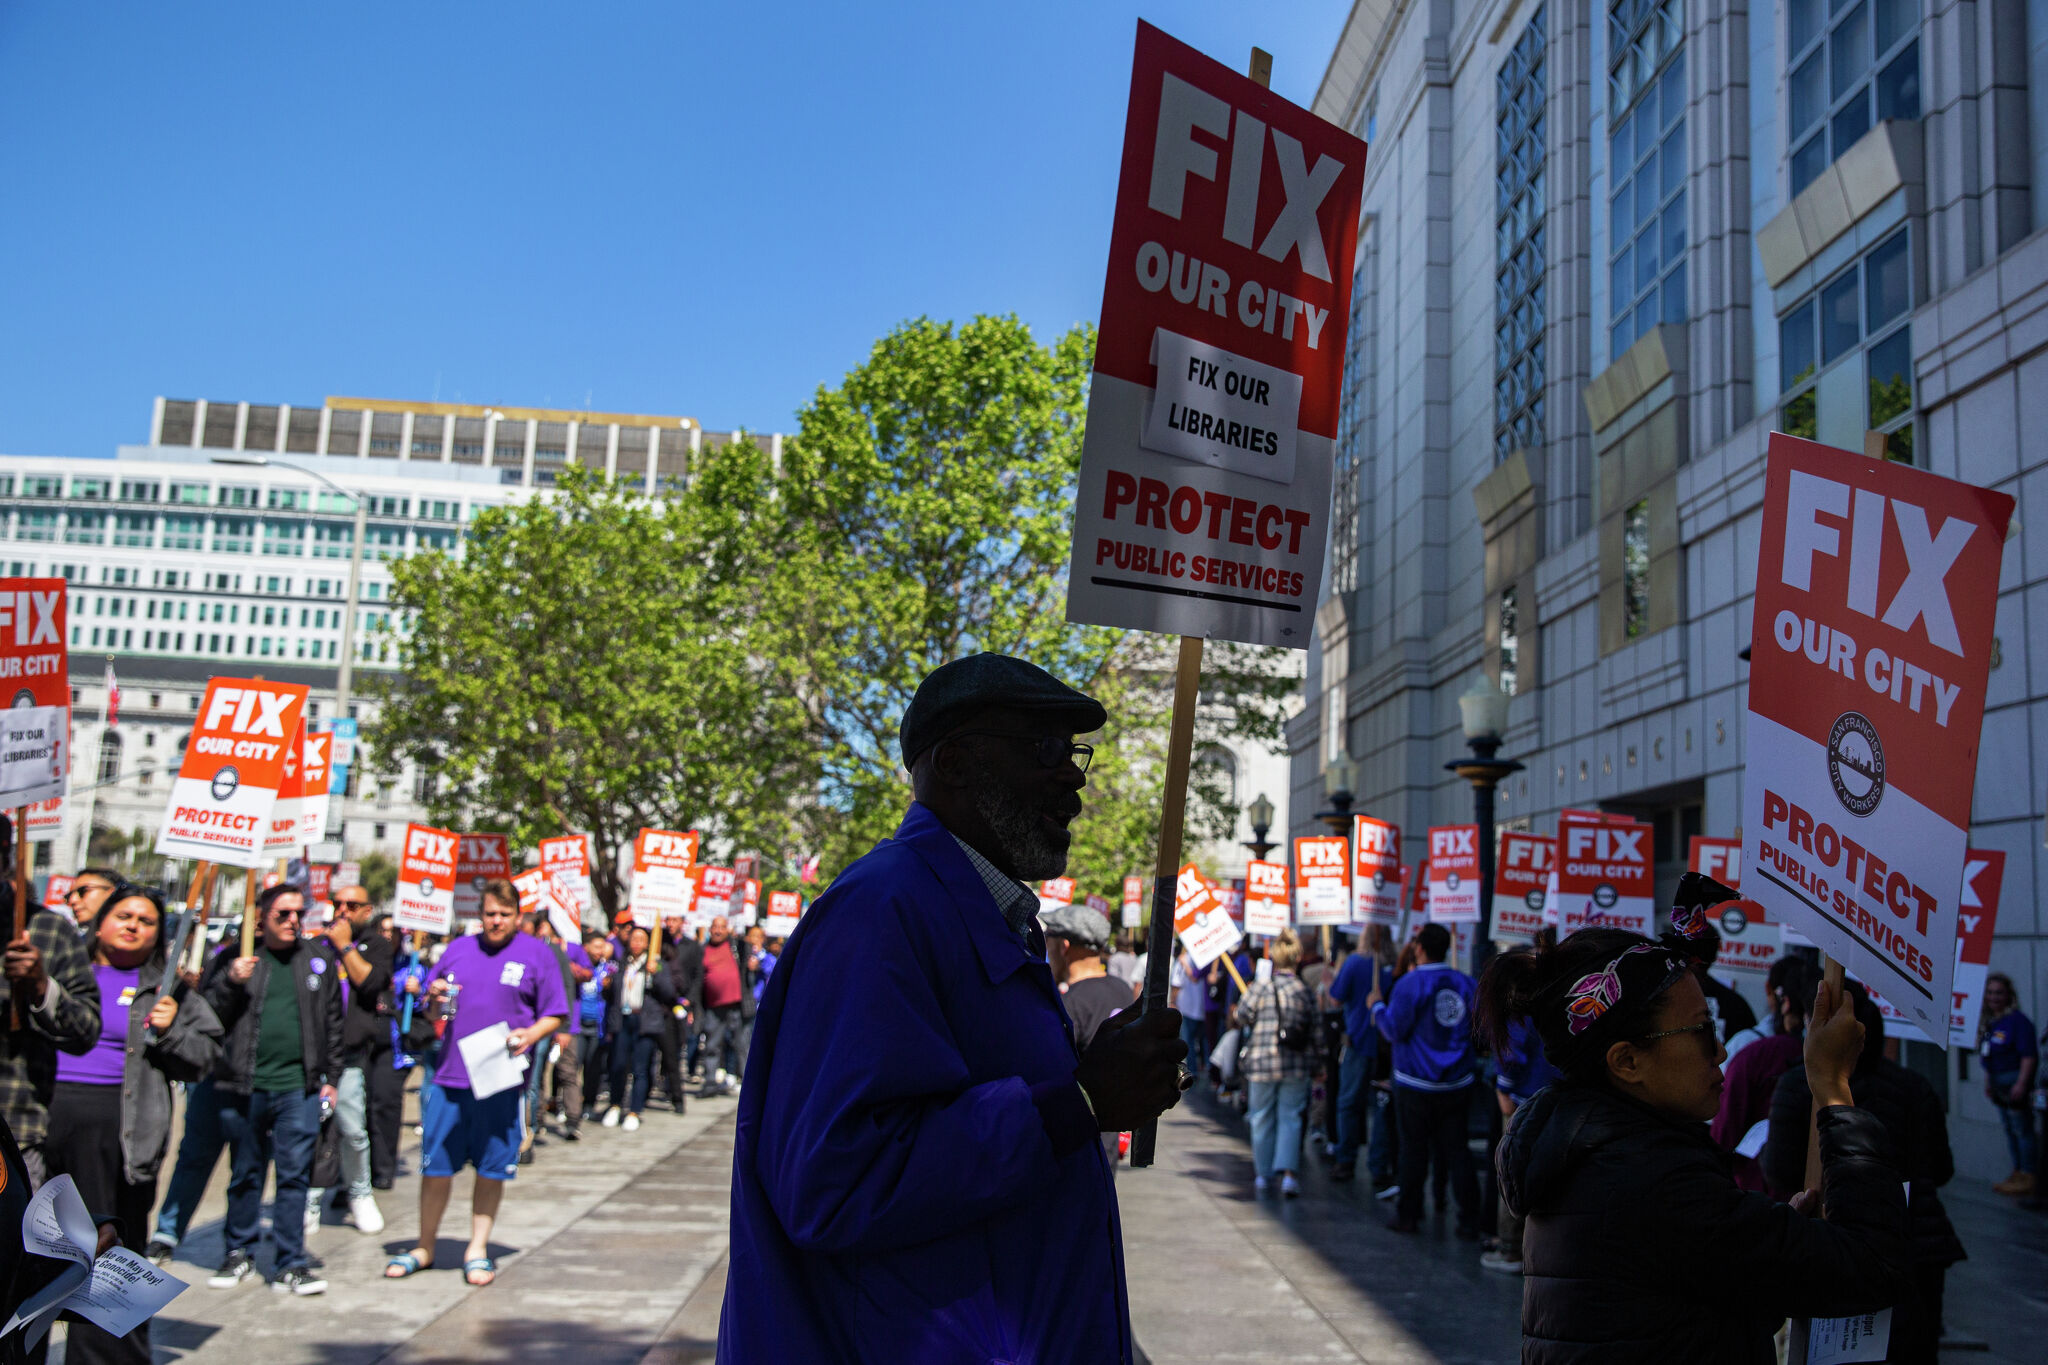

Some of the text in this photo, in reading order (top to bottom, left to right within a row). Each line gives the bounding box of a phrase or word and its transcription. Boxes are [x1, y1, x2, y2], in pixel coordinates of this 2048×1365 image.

[1148, 71, 1346, 284] FIX
[1135, 241, 1329, 350] OUR CITY
[1187, 356, 1270, 406] FIX OUR
[1168, 403, 1278, 456] LIBRARIES
[1102, 469, 1310, 555] PROTECT
[1096, 538, 1304, 597] PUBLIC SERVICES
[1782, 469, 1978, 658] FIX
[0, 653, 60, 678] UR CITY
[1774, 610, 1855, 681] OUR
[1864, 647, 1961, 728] CITY
[203, 687, 297, 737] FIX
[10, 728, 45, 741] FIX OUR
[196, 736, 235, 756] OUR
[234, 740, 280, 761] CITY
[1831, 717, 1883, 773] SAN FRANCISCO
[4, 748, 48, 763] LIBRARIES
[1557, 717, 1726, 786] FRANCIS
[1830, 762, 1880, 811] CITY WORKERS
[174, 806, 259, 831] PROTECT
[272, 819, 295, 832] UP
[408, 829, 456, 864] FIX
[544, 840, 584, 862] FIX
[643, 833, 692, 859] FIX
[1300, 842, 1344, 866] FIX
[1361, 822, 1397, 855] FIX
[1432, 829, 1475, 855] FIX
[1567, 827, 1645, 862] FIX
[406, 858, 452, 877] OUR CITY
[1249, 863, 1286, 886] FIX
[1504, 869, 1536, 884] OUR
[1566, 862, 1645, 878] OUR CITY
[1699, 845, 1740, 881] FI
[1762, 788, 1938, 937] PROTECT
[1759, 840, 1829, 903] PUBLIC
[1832, 890, 1934, 983] SERVICES
[1749, 943, 1775, 959] UP
[98, 1259, 141, 1285] Genocide!
[115, 1255, 128, 1264] on
[126, 1259, 145, 1275] May
[142, 1270, 164, 1286] Day!
